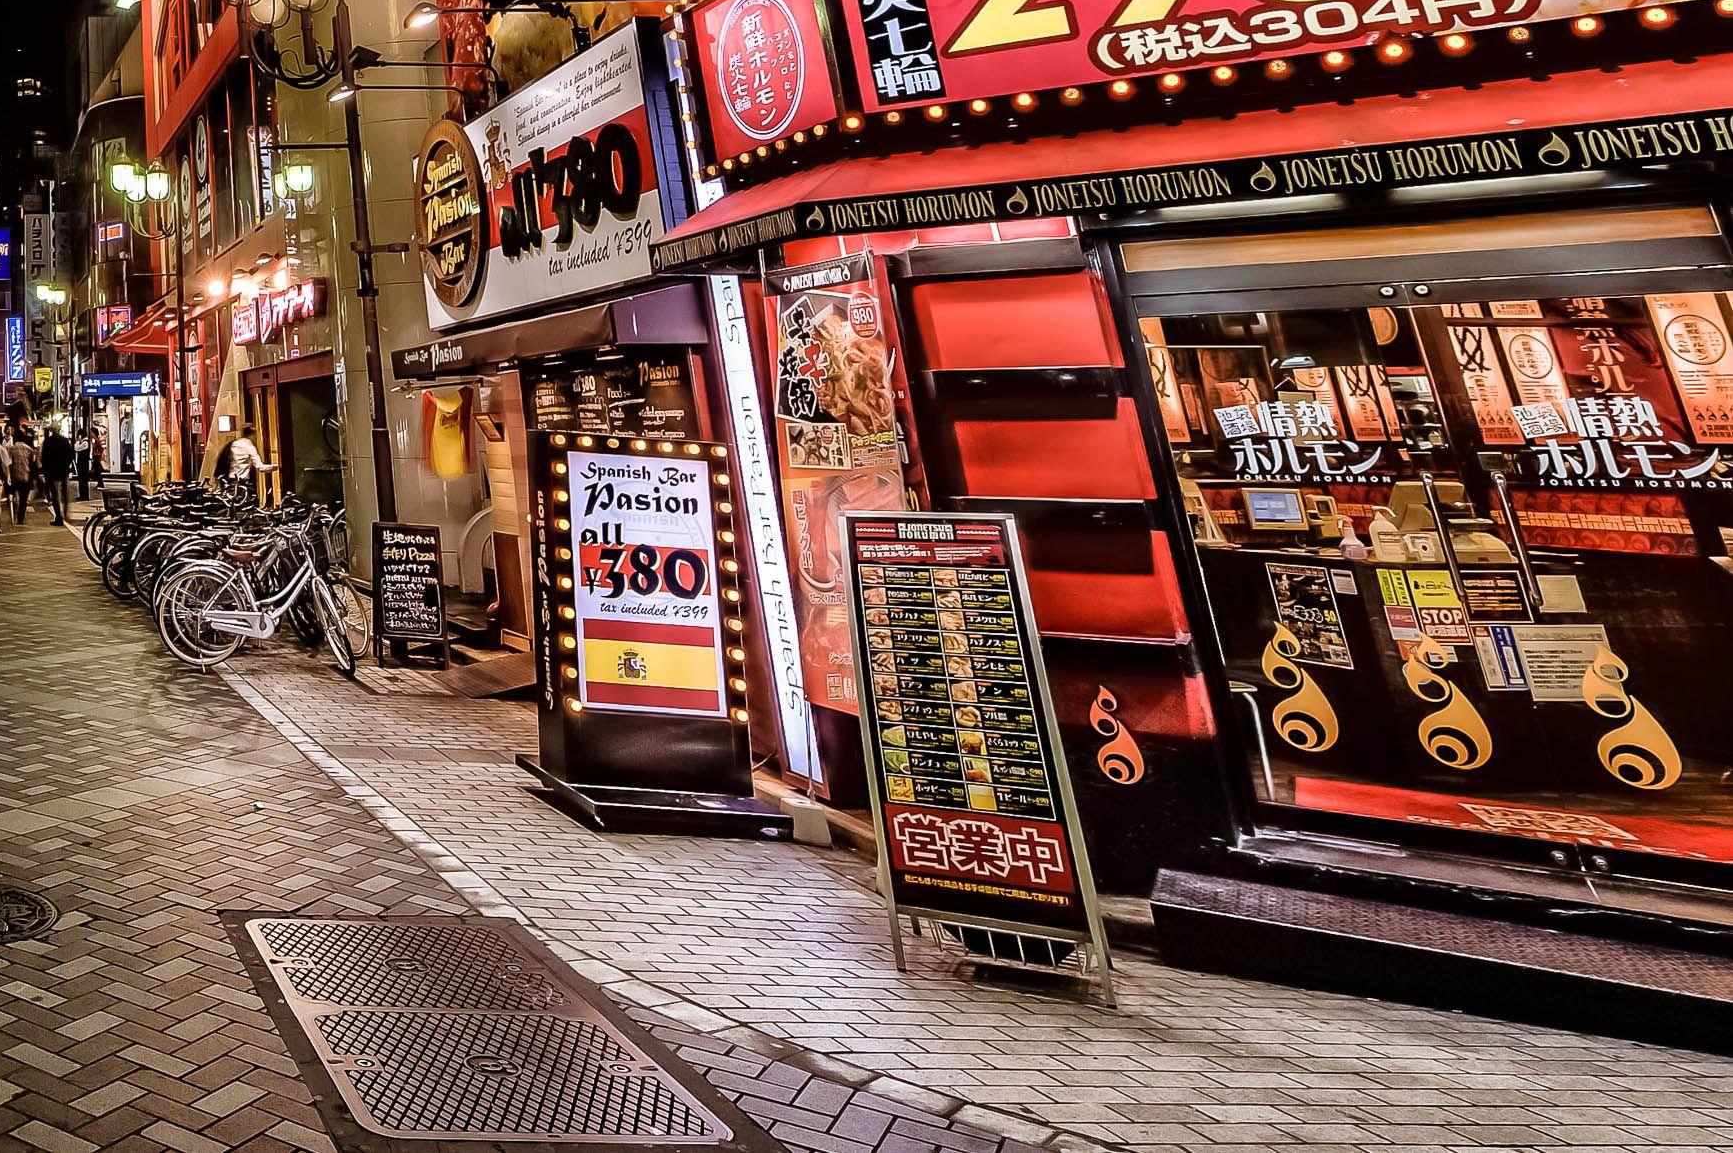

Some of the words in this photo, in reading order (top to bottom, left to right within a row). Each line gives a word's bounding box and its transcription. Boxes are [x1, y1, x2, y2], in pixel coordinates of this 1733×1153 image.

[728, 53, 753, 113] 炭火七輪
[740, 10, 777, 126] 新鮮ホルモン
[1574, 119, 1702, 169] JONETSU
[1704, 116, 1733, 152] H
[424, 150, 462, 195] Spanish
[1279, 151, 1383, 195] JONETSU
[1387, 137, 1525, 181] HORUMON
[827, 199, 899, 234] JONETSU
[904, 190, 996, 224] HORUMON
[1030, 177, 1116, 217] JONETSU
[1120, 167, 1233, 205] HORUMON
[425, 188, 472, 244] Pasion
[441, 241, 465, 275] Bar
[549, 255, 564, 276] tax
[566, 236, 611, 271] included
[614, 219, 653, 256] ¥399
[430, 341, 463, 372] Pasion
[637, 360, 679, 386] Pasion
[1256, 400, 1339, 437] 情熱
[1562, 395, 1664, 439] 情熱
[739, 394, 768, 499] Pasion
[1228, 438, 1382, 475] ホルモン
[1529, 439, 1720, 481] ホルモン
[580, 461, 651, 482] Spanish
[658, 467, 697, 487] Bar
[1236, 474, 1301, 482] JONETSU
[1312, 475, 1392, 484] HORUMON
[1539, 479, 1621, 487] JONETSU
[1635, 480, 1733, 489] HORUMON
[583, 481, 699, 518] Pasion
[408, 547, 436, 561] Pizza
[536, 490, 550, 587] Pasion
[580, 521, 626, 548] all
[584, 544, 709, 600] ¥380
[540, 591, 552, 632] Bar
[600, 602, 618, 614] tax
[620, 603, 668, 618] included
[672, 604, 709, 620] ¥399
[1423, 608, 1463, 625] STOP
[763, 579, 806, 716] Spanish
[543, 634, 554, 711] Spanish
[893, 812, 1065, 884] 営業中
